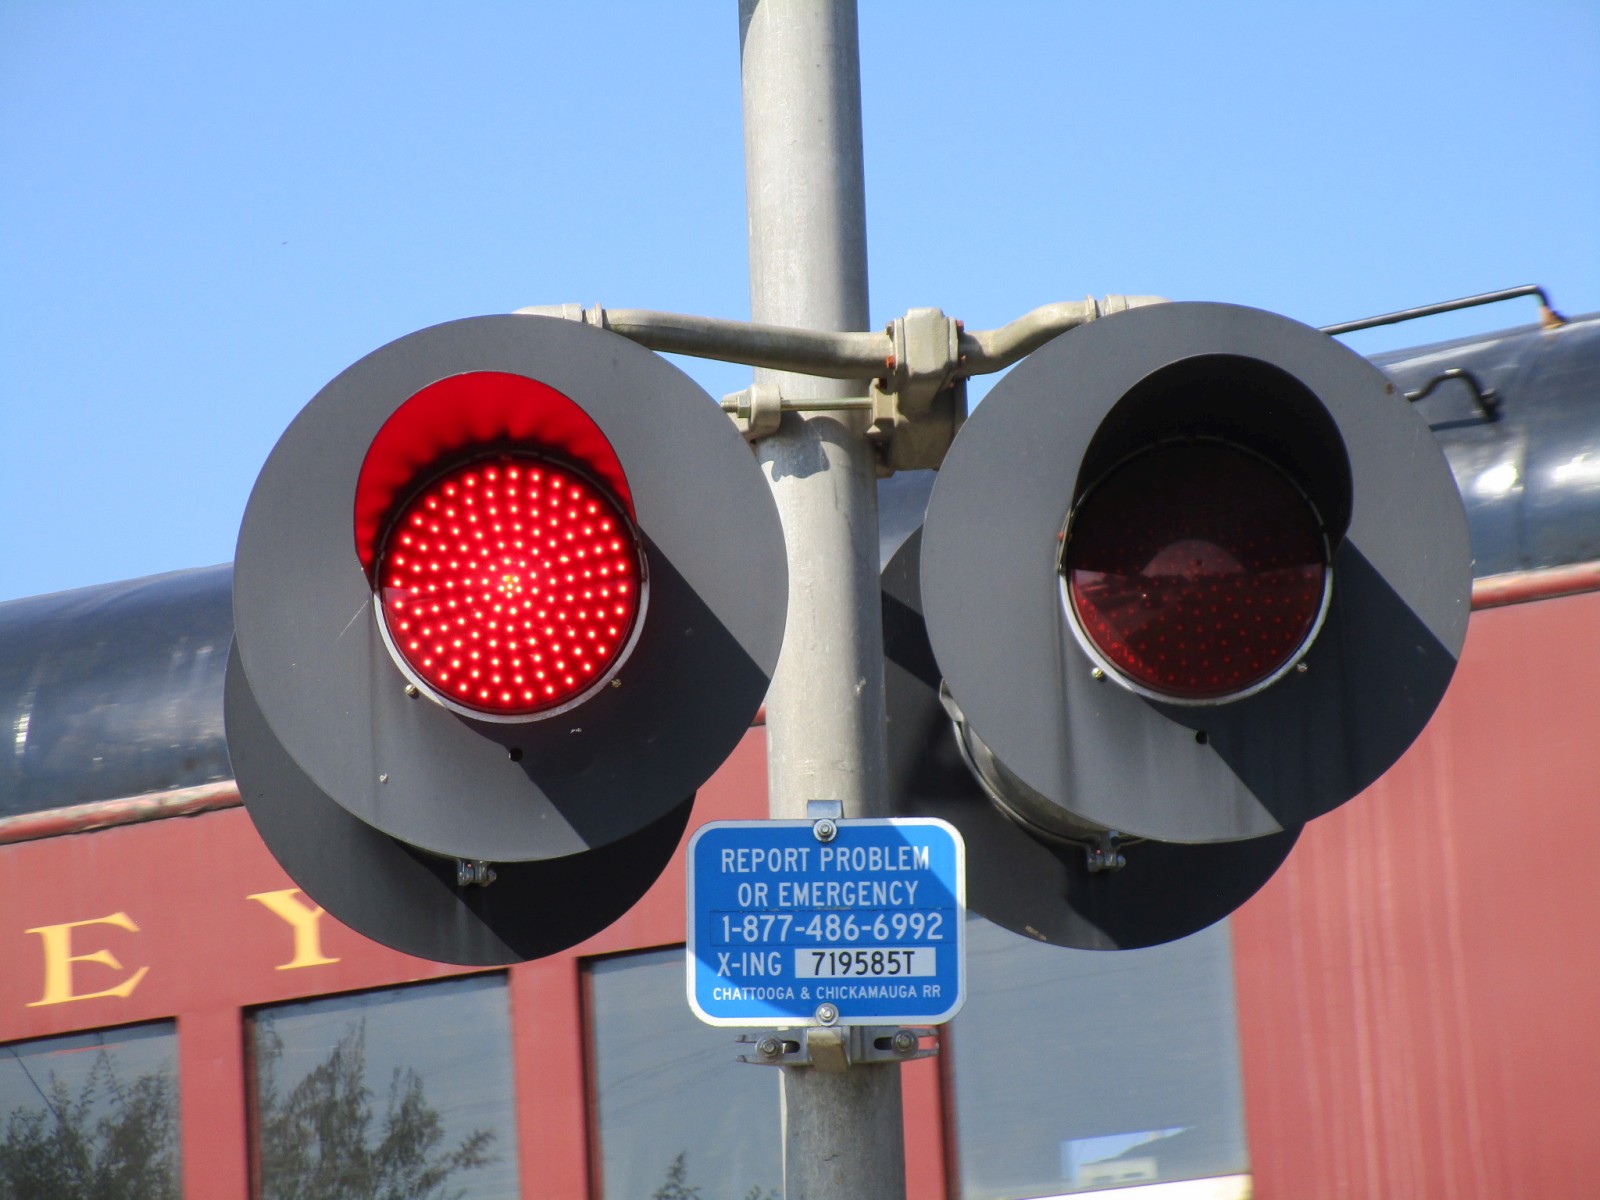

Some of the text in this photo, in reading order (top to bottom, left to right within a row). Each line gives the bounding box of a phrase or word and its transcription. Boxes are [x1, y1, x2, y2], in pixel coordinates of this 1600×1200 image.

[721, 845, 930, 873] REPORT PROBLEM
[737, 881, 918, 907] OR EMERGENCY
[722, 913, 943, 942] 1-877-486-6992
[717, 950, 915, 977] X-ING 719585T
[713, 984, 941, 1001] CHATTOOGA & CHICKAMAUGA RR
